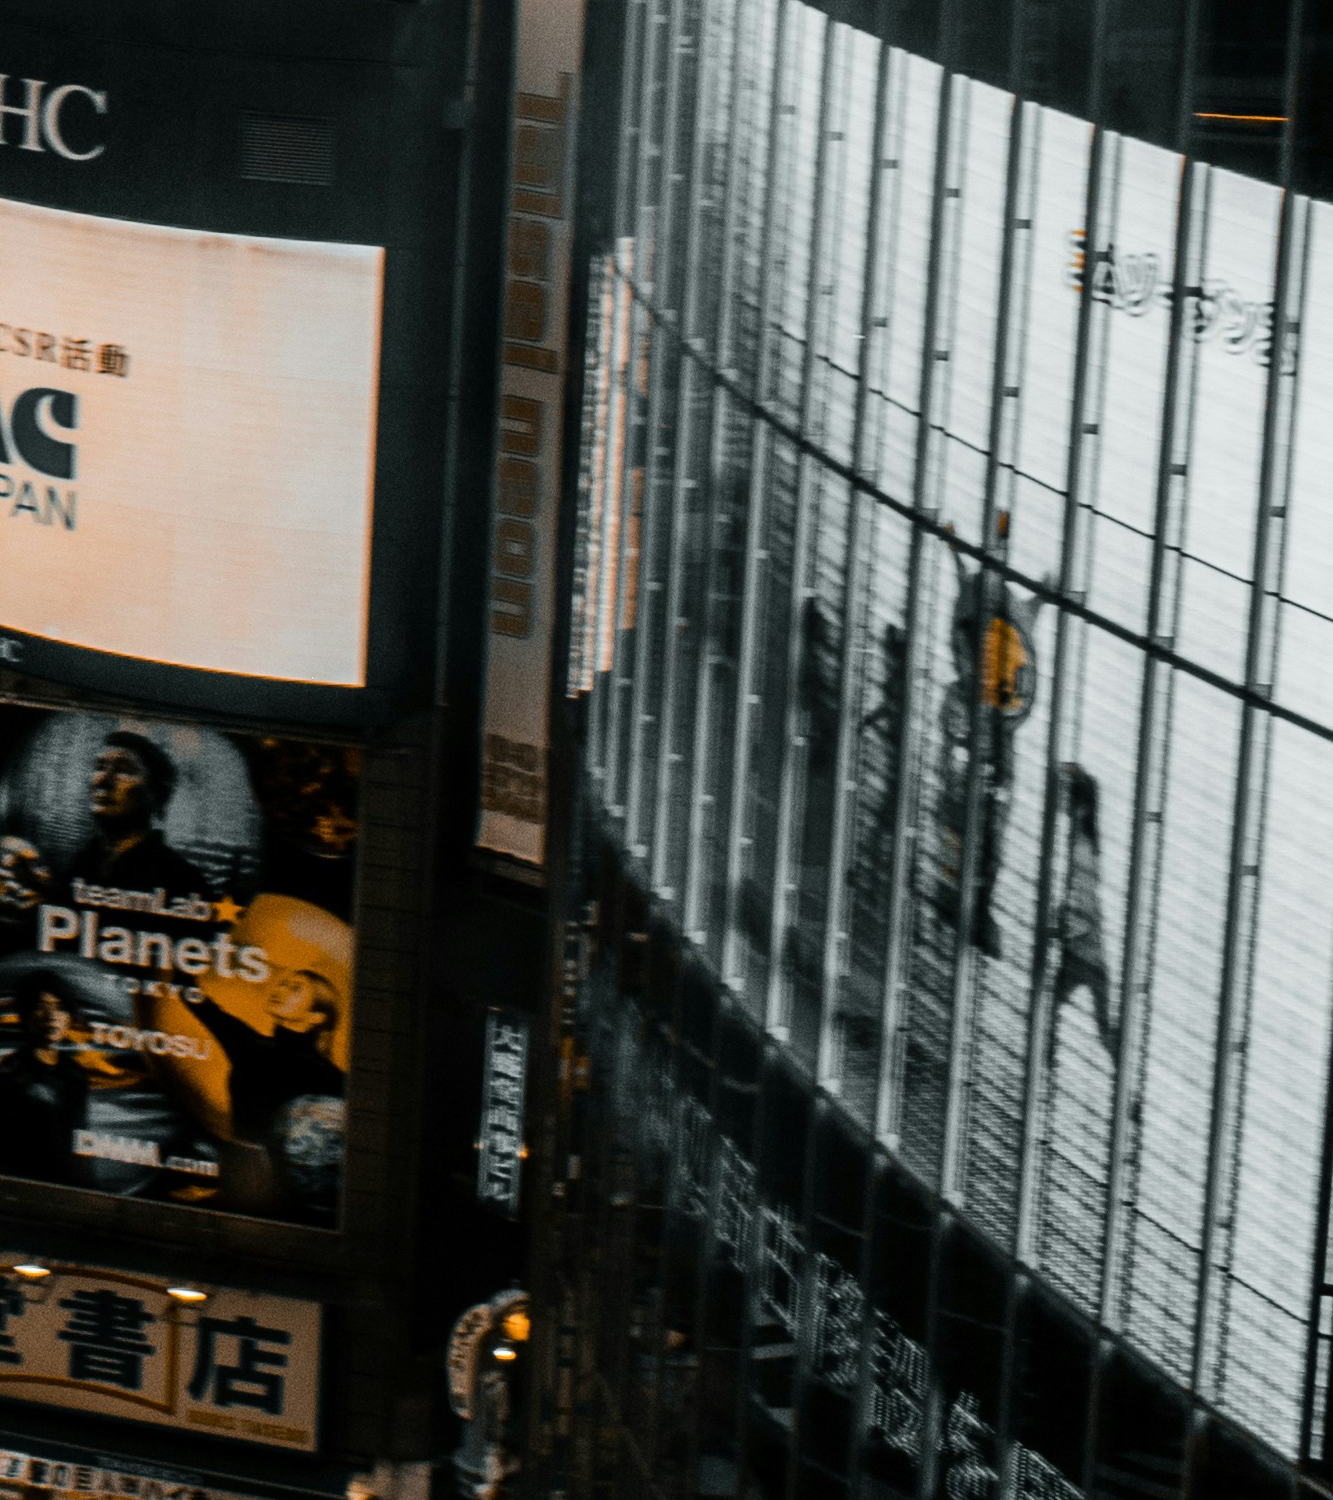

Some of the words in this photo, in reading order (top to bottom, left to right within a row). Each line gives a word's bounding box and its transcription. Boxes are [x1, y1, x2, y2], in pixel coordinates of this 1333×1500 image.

[70, 877, 213, 922] teamLab
[35, 902, 272, 983] Planets
[87, 1020, 213, 1062] TOYOSU
